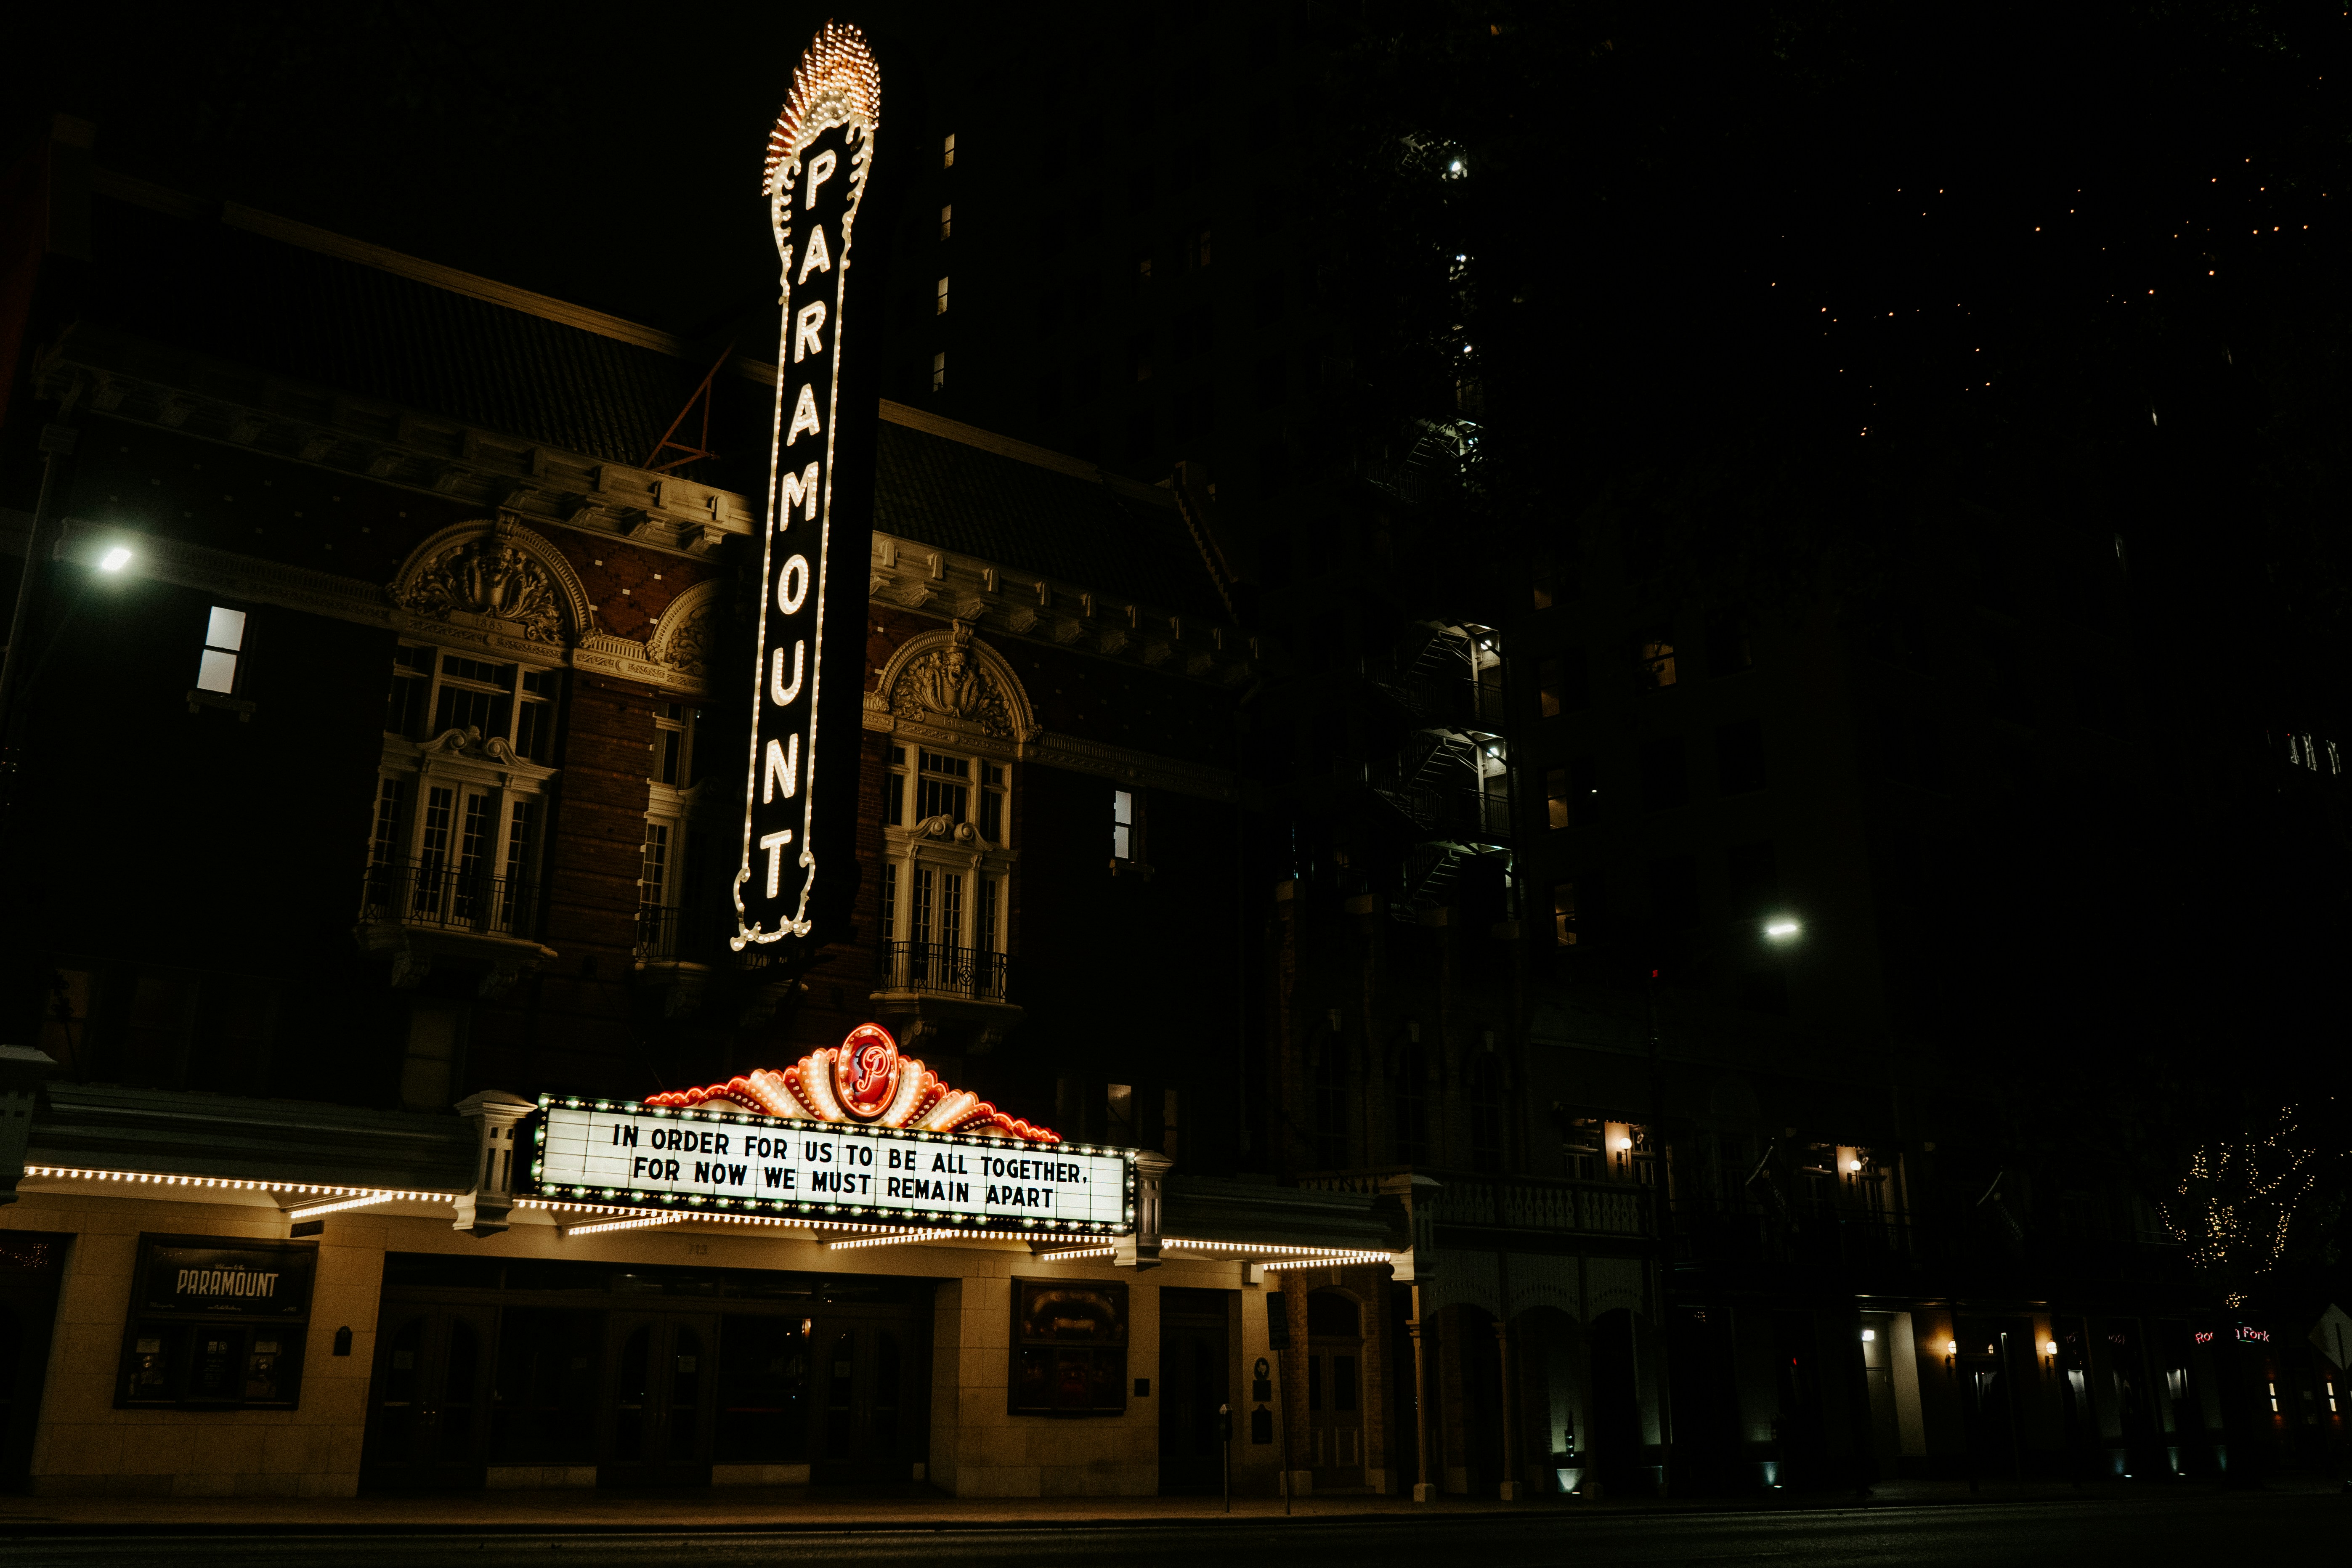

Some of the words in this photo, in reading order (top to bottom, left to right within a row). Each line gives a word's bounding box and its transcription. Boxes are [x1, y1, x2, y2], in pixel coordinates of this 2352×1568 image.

[760, 149, 836, 899] PARAMOUNT
[613, 1124, 639, 1148] IN
[651, 1128, 730, 1155] ORDER
[745, 1136, 788, 1160] FOR
[805, 1141, 833, 1163] US
[846, 1144, 873, 1166] TO
[888, 1148, 916, 1171] BE
[931, 1152, 968, 1175] ALL
[981, 1156, 1088, 1184] TOGETHER,
[633, 1156, 680, 1181] FOR
[695, 1161, 748, 1186] NOW
[765, 1166, 796, 1189] WE
[812, 1171, 871, 1195] MUST
[887, 1177, 969, 1203] REMAIN
[986, 1184, 1054, 1208] APART
[176, 1269, 280, 1297] PARAMOUNT
[2243, 1326, 2270, 1342] Fork
